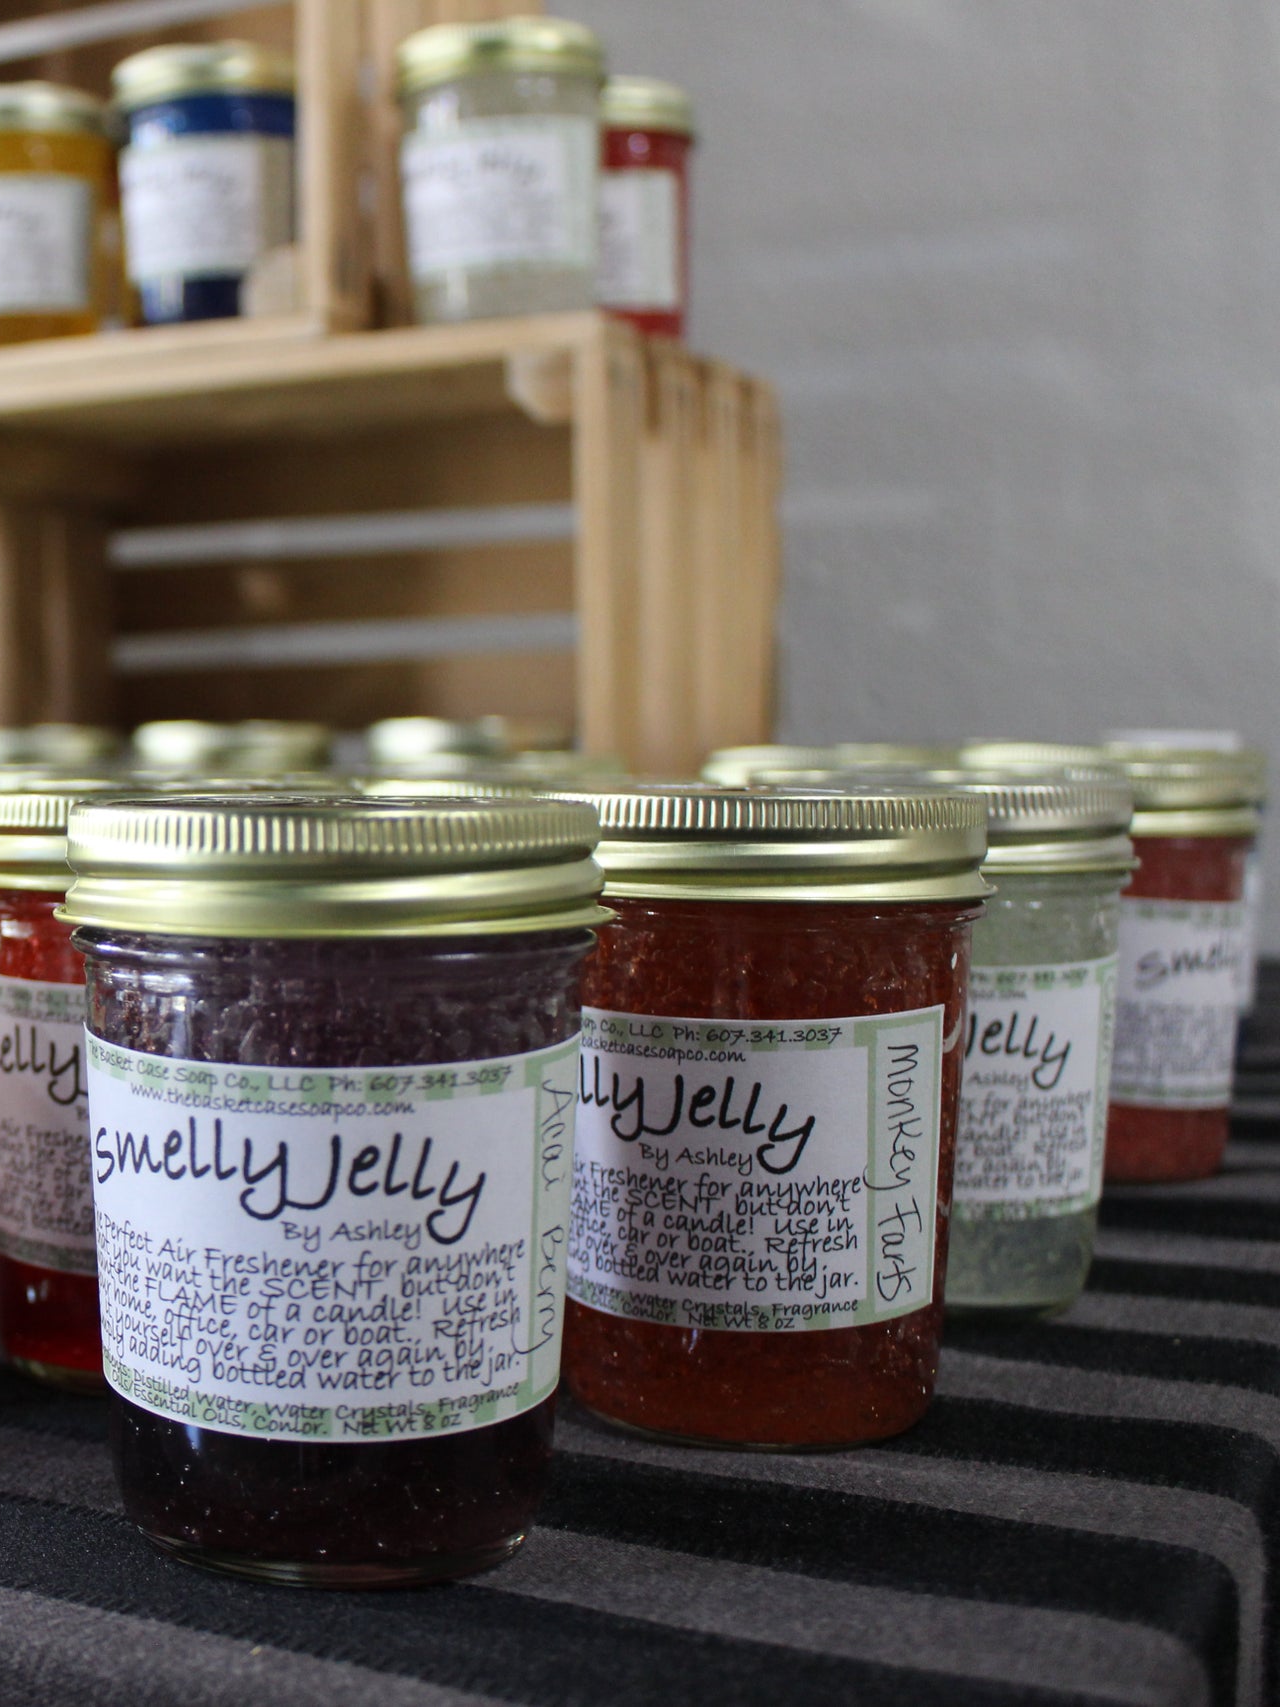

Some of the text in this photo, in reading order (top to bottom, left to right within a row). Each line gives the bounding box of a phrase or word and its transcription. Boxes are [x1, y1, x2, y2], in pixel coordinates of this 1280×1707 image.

[600, 1018, 843, 1045] Co., LLC Ph: 607.341.3037
[965, 1012, 1071, 1090] Jelly
[100, 1046, 134, 1072] Basket
[136, 1060, 171, 1080] Case
[173, 1067, 218, 1093] Soap
[267, 1076, 315, 1092] LLC
[328, 1075, 362, 1092] Ph:
[131, 1081, 415, 1124] www.thebasketcasesoapco.com
[643, 1073, 815, 1174] Jelly
[862, 1043, 924, 1193] Monkey
[639, 1143, 752, 1176] By Ashley
[286, 1132, 486, 1246] Jelly
[590, 1162, 861, 1204] Freshener for anywhere
[594, 1183, 619, 1203] the
[735, 1193, 778, 1216] but
[281, 1221, 421, 1253] By Ashley
[510, 1078, 574, 1355] Acai Berry
[617, 1204, 854, 1236] of a candle! Use in
[103, 1214, 525, 1281] Perfect Air Freshener for anywhere
[586, 1236, 618, 1254] over
[645, 1250, 692, 1270] over
[699, 1251, 778, 1278] again
[618, 1227, 650, 1244] car
[657, 1234, 680, 1248] or
[764, 1231, 858, 1257] Refresh
[113, 1245, 140, 1276] you
[146, 1258, 202, 1288] want
[210, 1269, 250, 1296] the
[401, 1273, 449, 1298] but
[596, 1254, 859, 1299] bottled water to the jar.
[113, 1284, 158, 1322] home,
[164, 1304, 238, 1340] office,
[248, 1323, 296, 1344] car
[303, 1325, 332, 1346] or
[433, 1305, 520, 1340] Refresh
[117, 1267, 518, 1329] the FLAME of a candle! Use in
[629, 1291, 859, 1320] Water Crystals, Fragrance
[724, 1315, 751, 1328] Wt
[758, 1313, 769, 1329] 8
[775, 1317, 796, 1329] oz
[115, 1306, 190, 1349] yourself
[196, 1337, 250, 1362] over
[258, 1344, 277, 1366] &
[287, 1348, 348, 1370] over
[357, 1343, 446, 1374] again
[128, 1335, 201, 1384] adding
[212, 1360, 307, 1390] bottled
[317, 1366, 401, 1390] water
[407, 1365, 434, 1387] to
[443, 1358, 481, 1383] the
[481, 1346, 521, 1387] jar.
[133, 1369, 520, 1420] Distilled Water, Water Crystals, Fragrance
[202, 1408, 247, 1430] Oils,
[342, 1419, 379, 1435] Net
[386, 1420, 417, 1433] Wt
[423, 1415, 435, 1431] 8
[441, 1414, 462, 1427] oz
